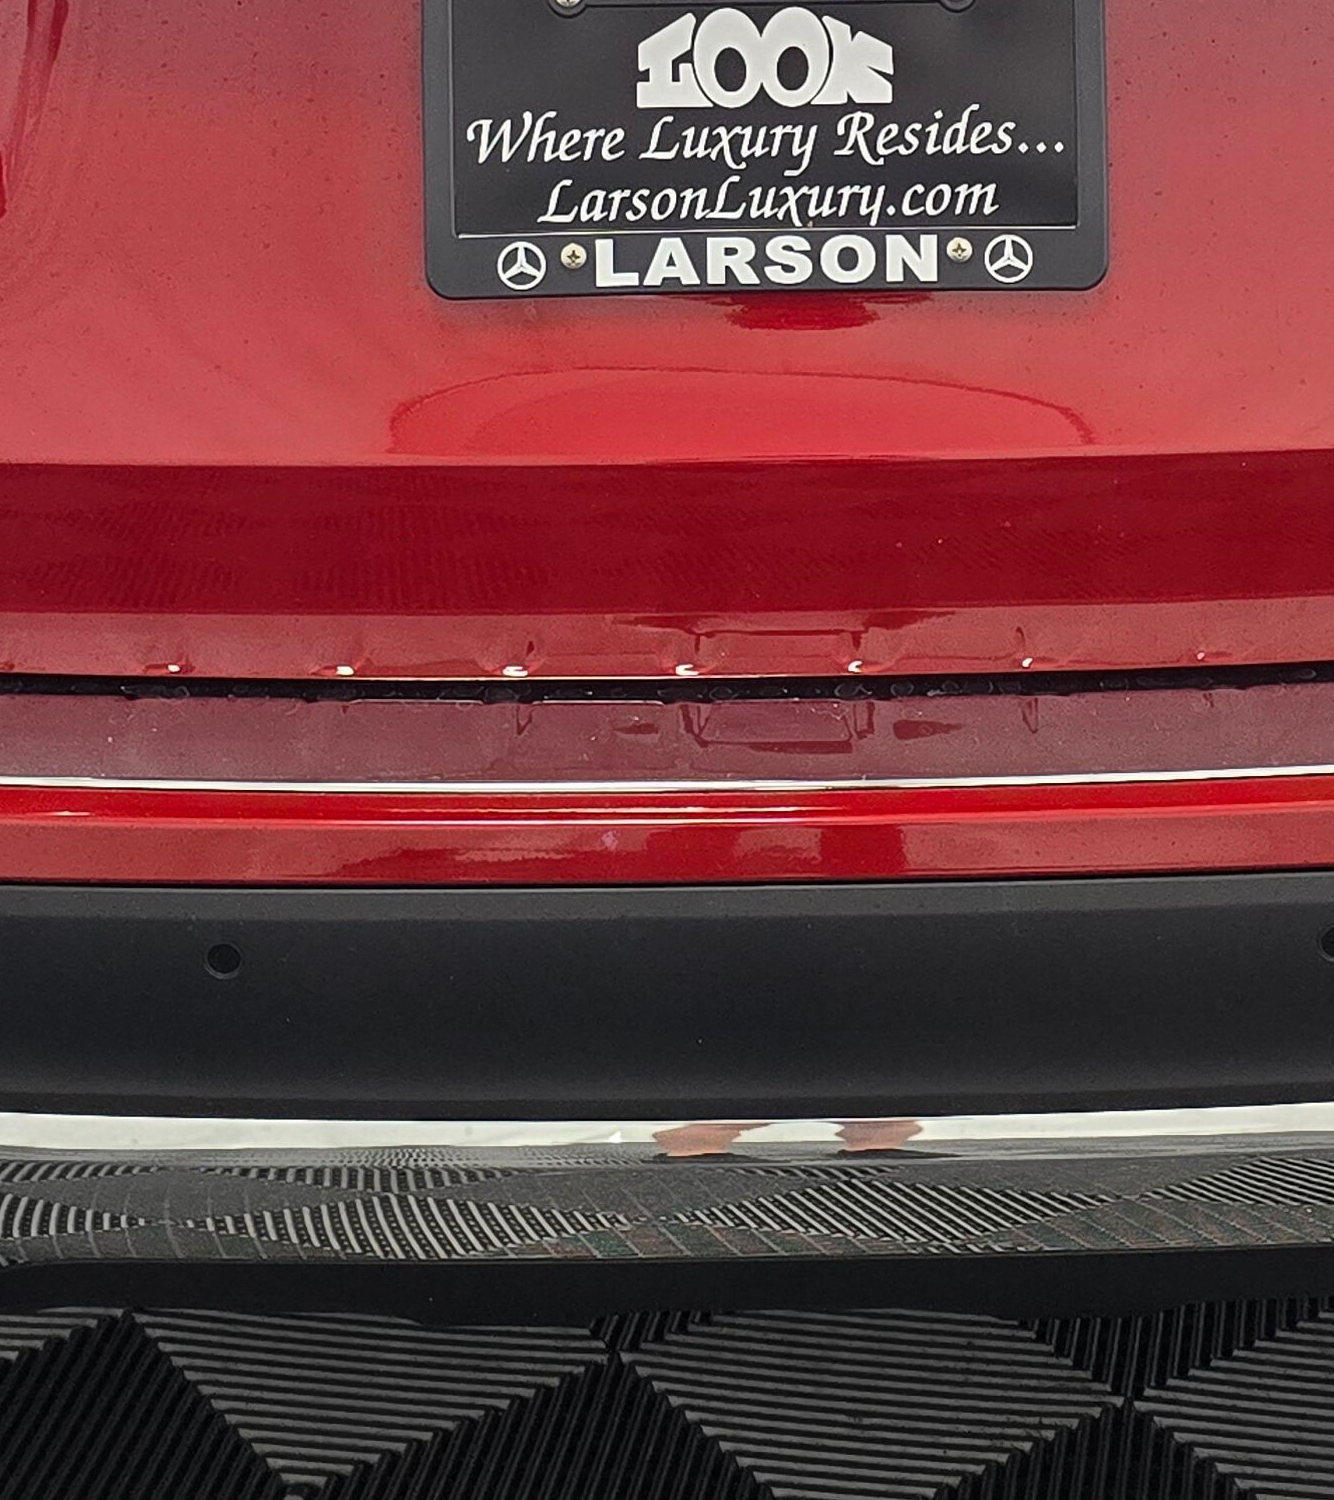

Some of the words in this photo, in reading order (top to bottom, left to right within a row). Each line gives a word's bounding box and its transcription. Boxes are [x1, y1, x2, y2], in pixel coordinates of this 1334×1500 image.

[466, 110, 625, 164] Where
[638, 115, 818, 177] Luxury
[833, 103, 1065, 166] Resides...
[536, 175, 1000, 228] LarsonLuxury.com
[593, 233, 939, 288] LARSON
